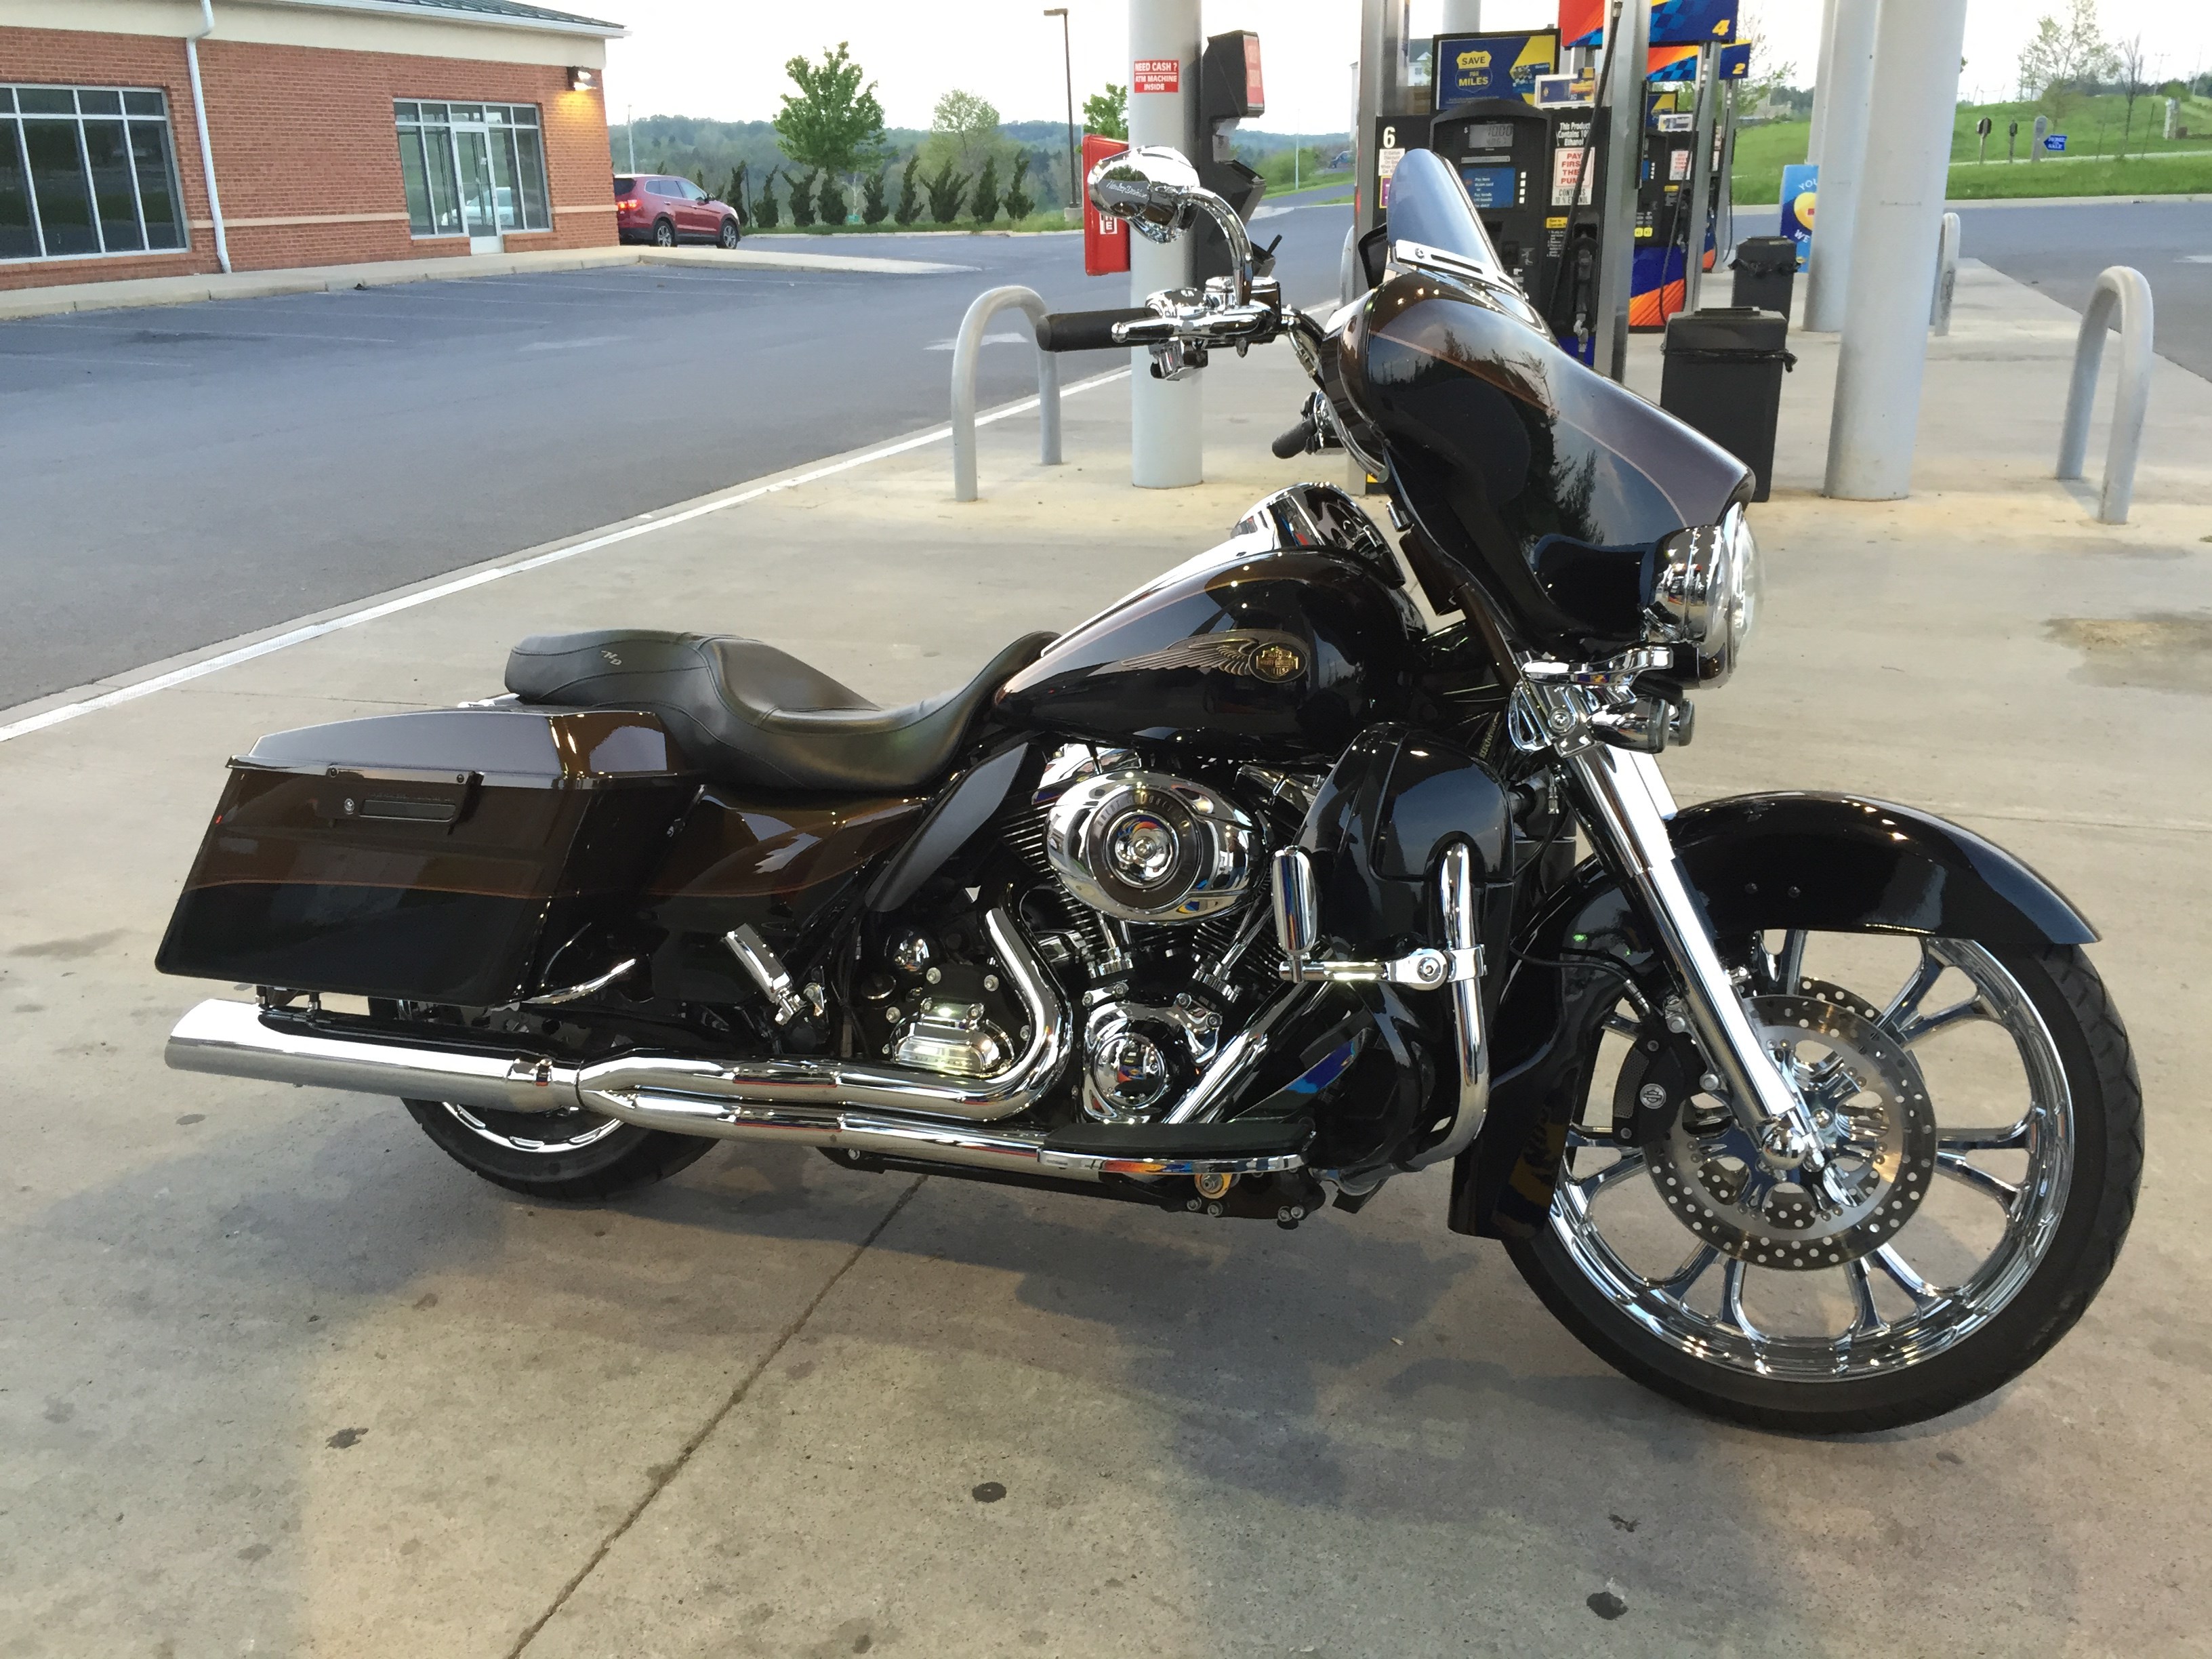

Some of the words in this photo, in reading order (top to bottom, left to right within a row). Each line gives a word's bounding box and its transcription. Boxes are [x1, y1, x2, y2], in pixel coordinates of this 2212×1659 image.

[1712, 19, 1730, 36] 4
[1462, 56, 1486, 65] SAVE
[1134, 62, 1150, 71] NEED
[1152, 62, 1171, 71] CASH
[1732, 62, 1746, 75] 2
[1458, 77, 1488, 87] MILES
[1560, 122, 1570, 130] This
[1383, 126, 1395, 148] 6
[1558, 130, 1579, 138] Contains
[1581, 129, 1589, 138] 10
